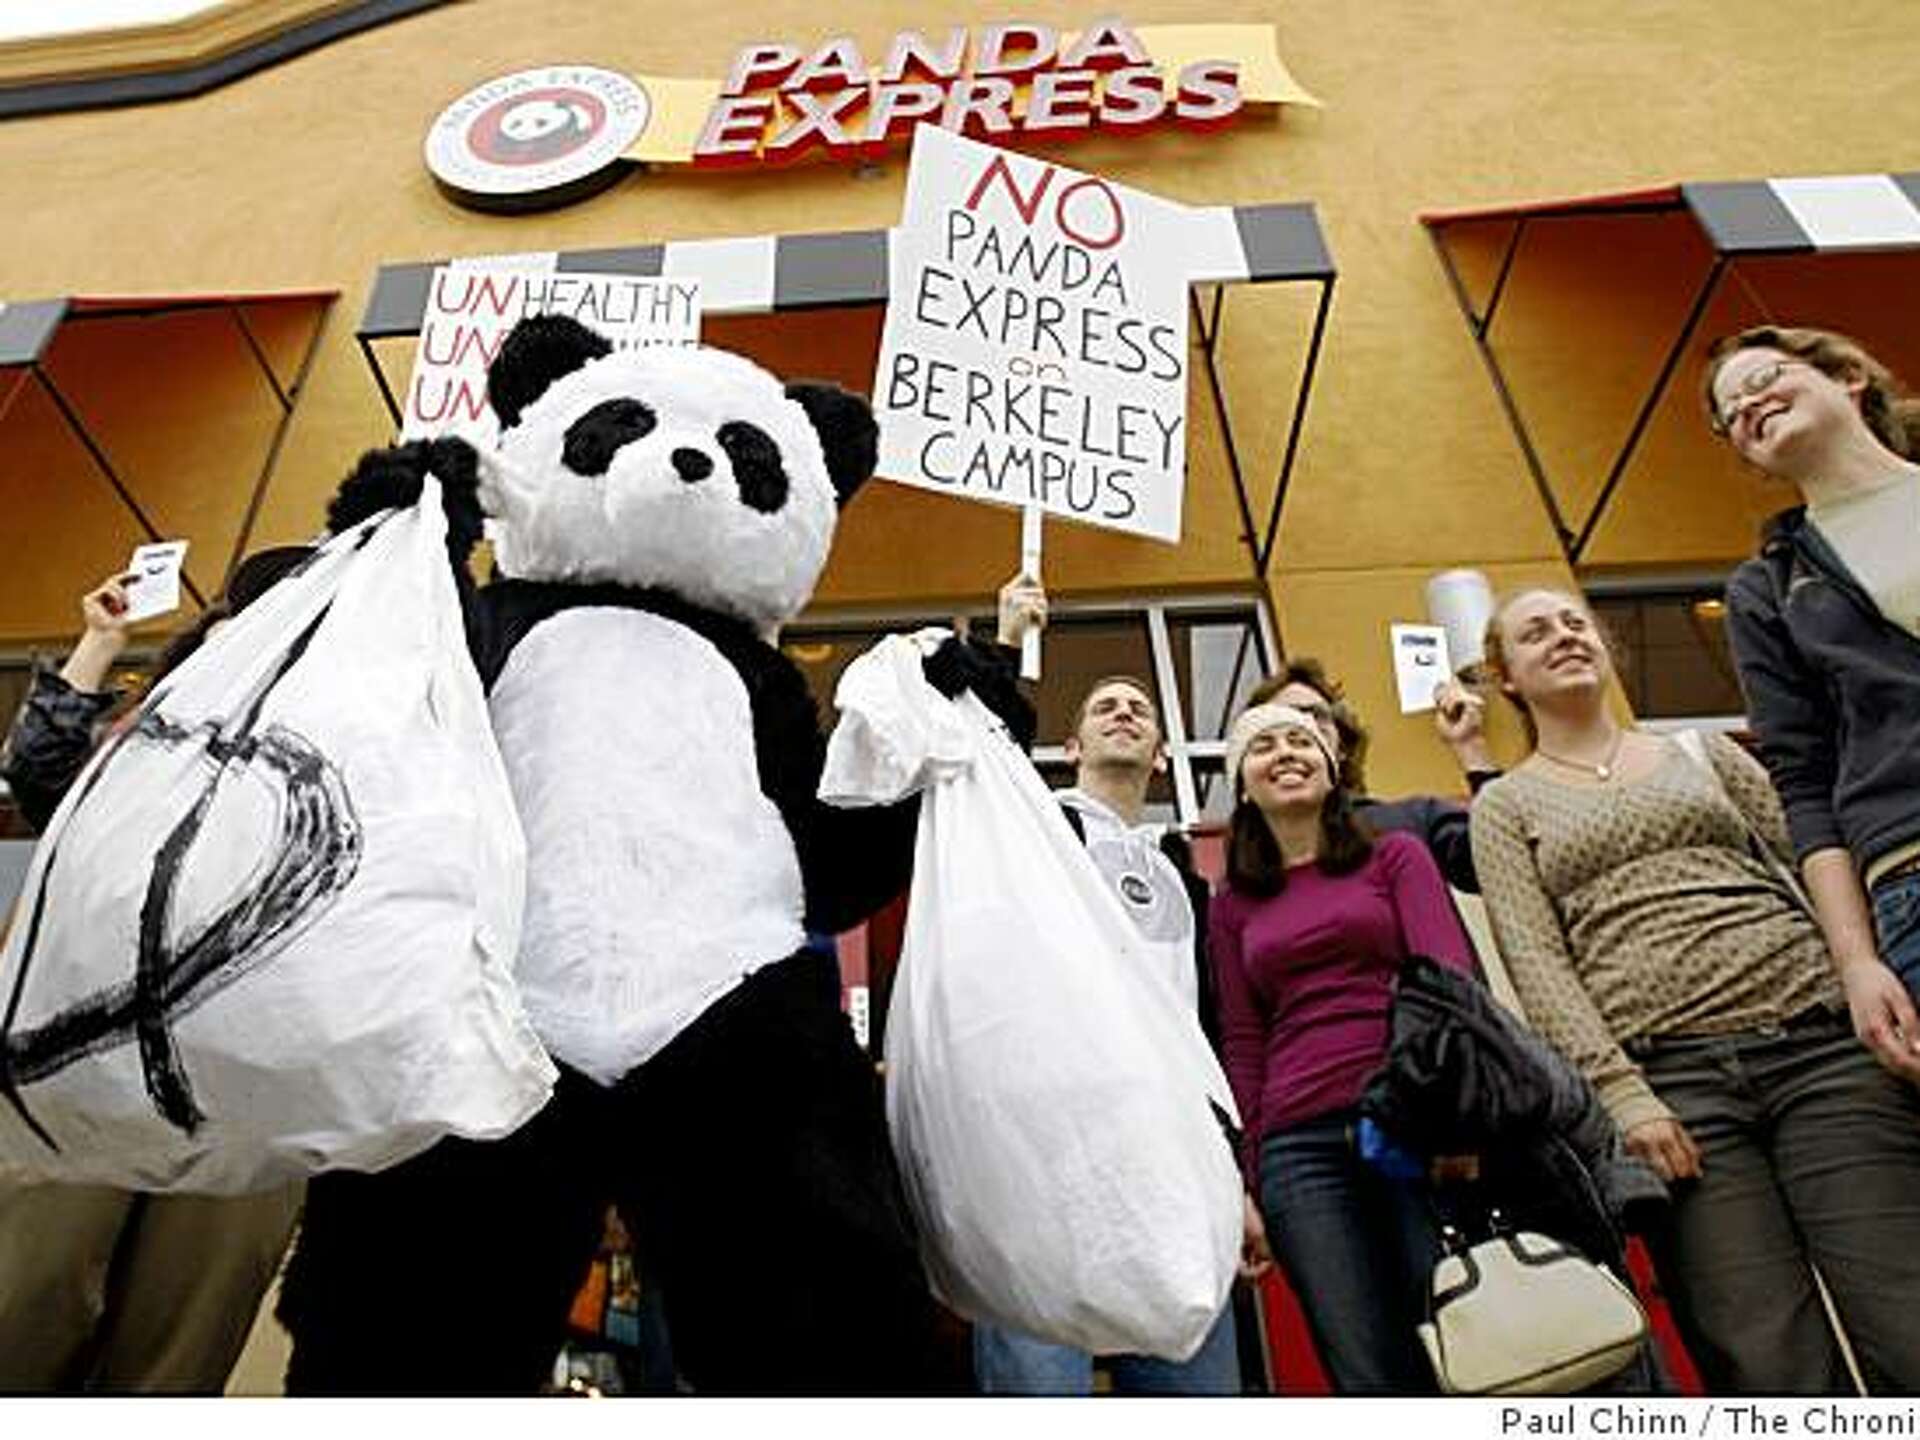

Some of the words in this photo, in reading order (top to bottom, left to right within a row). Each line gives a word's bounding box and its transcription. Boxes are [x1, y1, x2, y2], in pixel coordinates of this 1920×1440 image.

[720, 20, 1150, 97] PANDA
[693, 61, 1243, 156] EXPRESS
[965, 153, 1125, 250] NO
[947, 209, 1127, 305] PANDA
[916, 266, 1183, 382] EXPRESS
[1007, 356, 1067, 381] on
[888, 352, 1183, 471] BERKELEY
[920, 431, 1137, 520] CAMPUS
